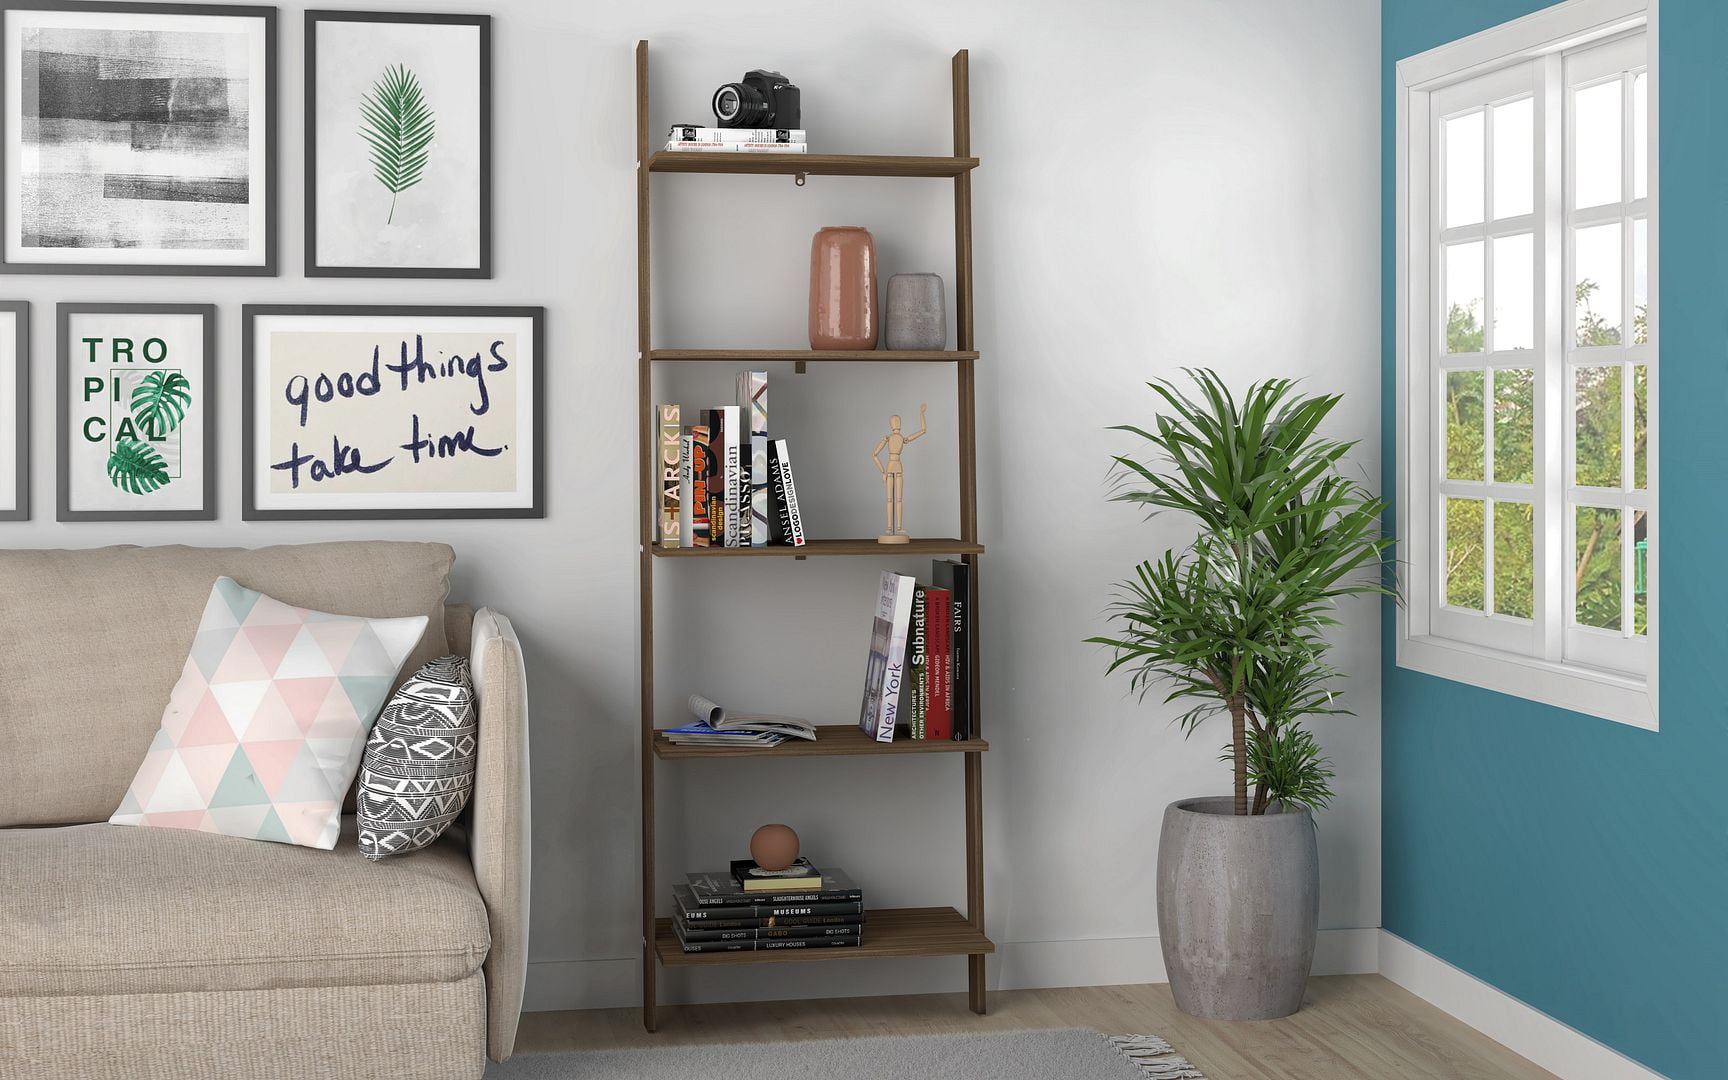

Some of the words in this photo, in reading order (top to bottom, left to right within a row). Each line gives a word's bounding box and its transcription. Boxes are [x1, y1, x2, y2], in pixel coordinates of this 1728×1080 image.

[285, 345, 381, 426] good
[386, 334, 508, 415] things
[271, 436, 395, 488] take
[694, 445, 706, 515] PIN-UP
[770, 458, 785, 502] ADAMS
[726, 446, 737, 547] Scandinavian
[740, 470, 752, 547] PICASSO
[778, 506, 793, 544] ANSEL
[912, 590, 925, 665] Subnature
[954, 601, 962, 633] FAIRS
[885, 663, 902, 697] York
[880, 703, 897, 739] New
[773, 907, 811, 915] MUSEUMS
